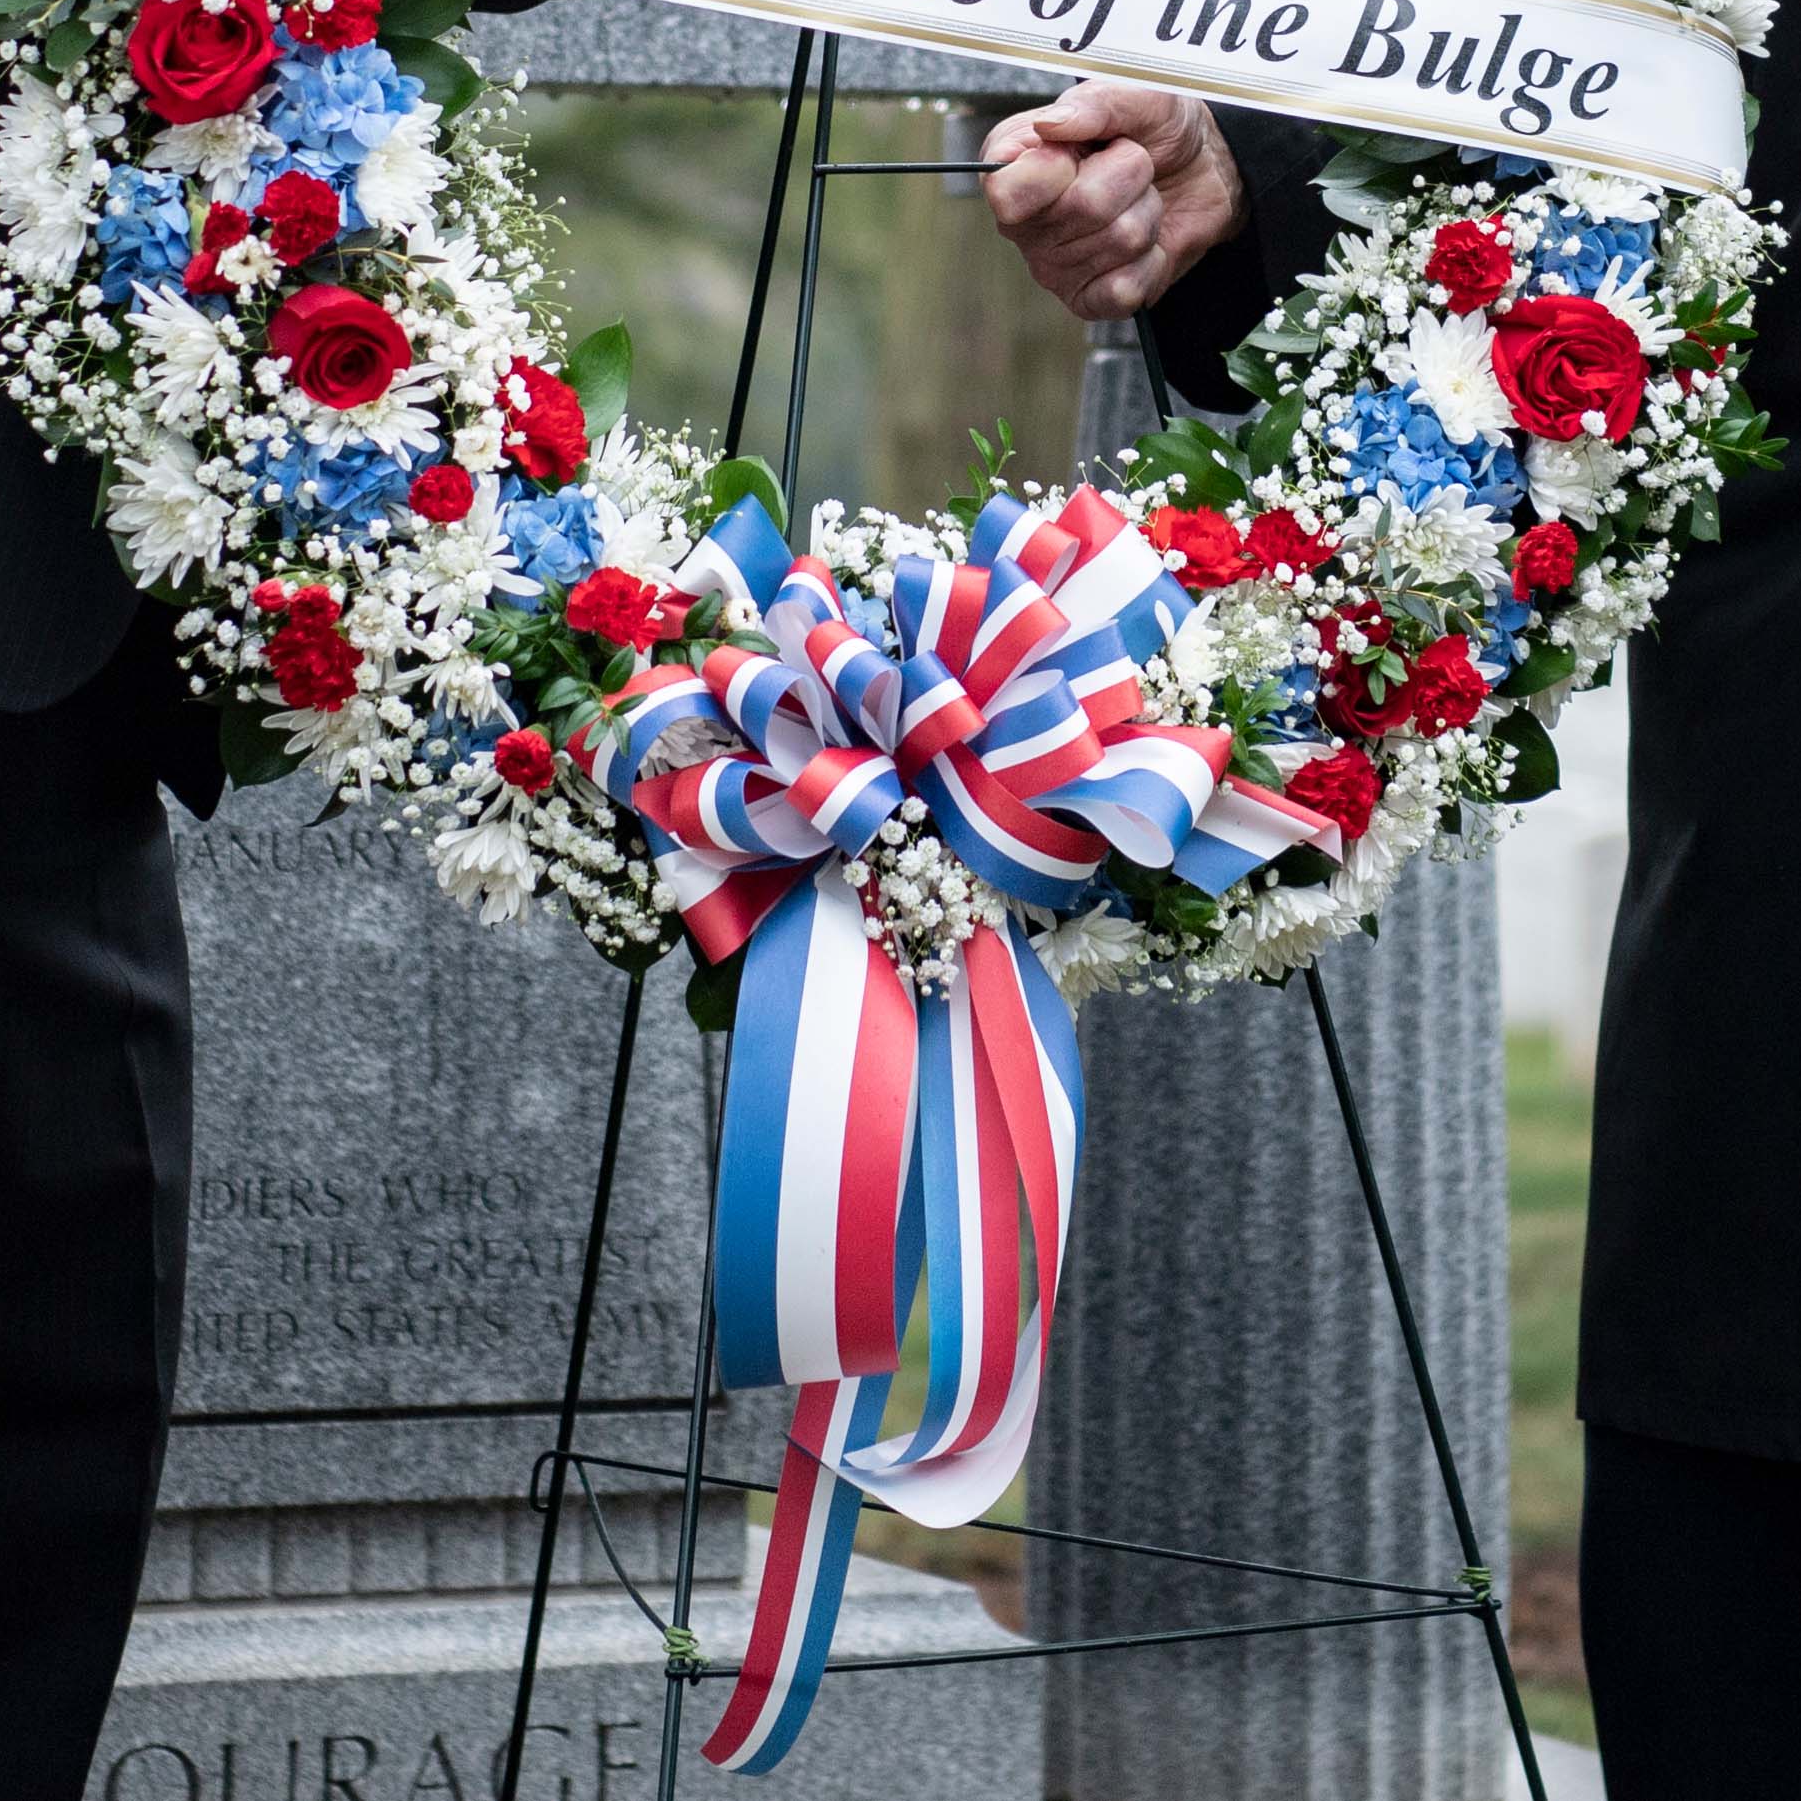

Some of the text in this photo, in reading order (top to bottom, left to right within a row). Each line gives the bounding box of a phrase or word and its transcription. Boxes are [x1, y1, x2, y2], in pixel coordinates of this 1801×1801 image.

[174, 828, 409, 874] JANUARY
[200, 1174, 347, 1223] DIERS
[380, 1170, 523, 1214] WHO
[273, 1241, 367, 1287] THE
[399, 1232, 659, 1285] GREATST
[331, 1302, 506, 1354] STATES
[543, 1297, 687, 1343] AMY
